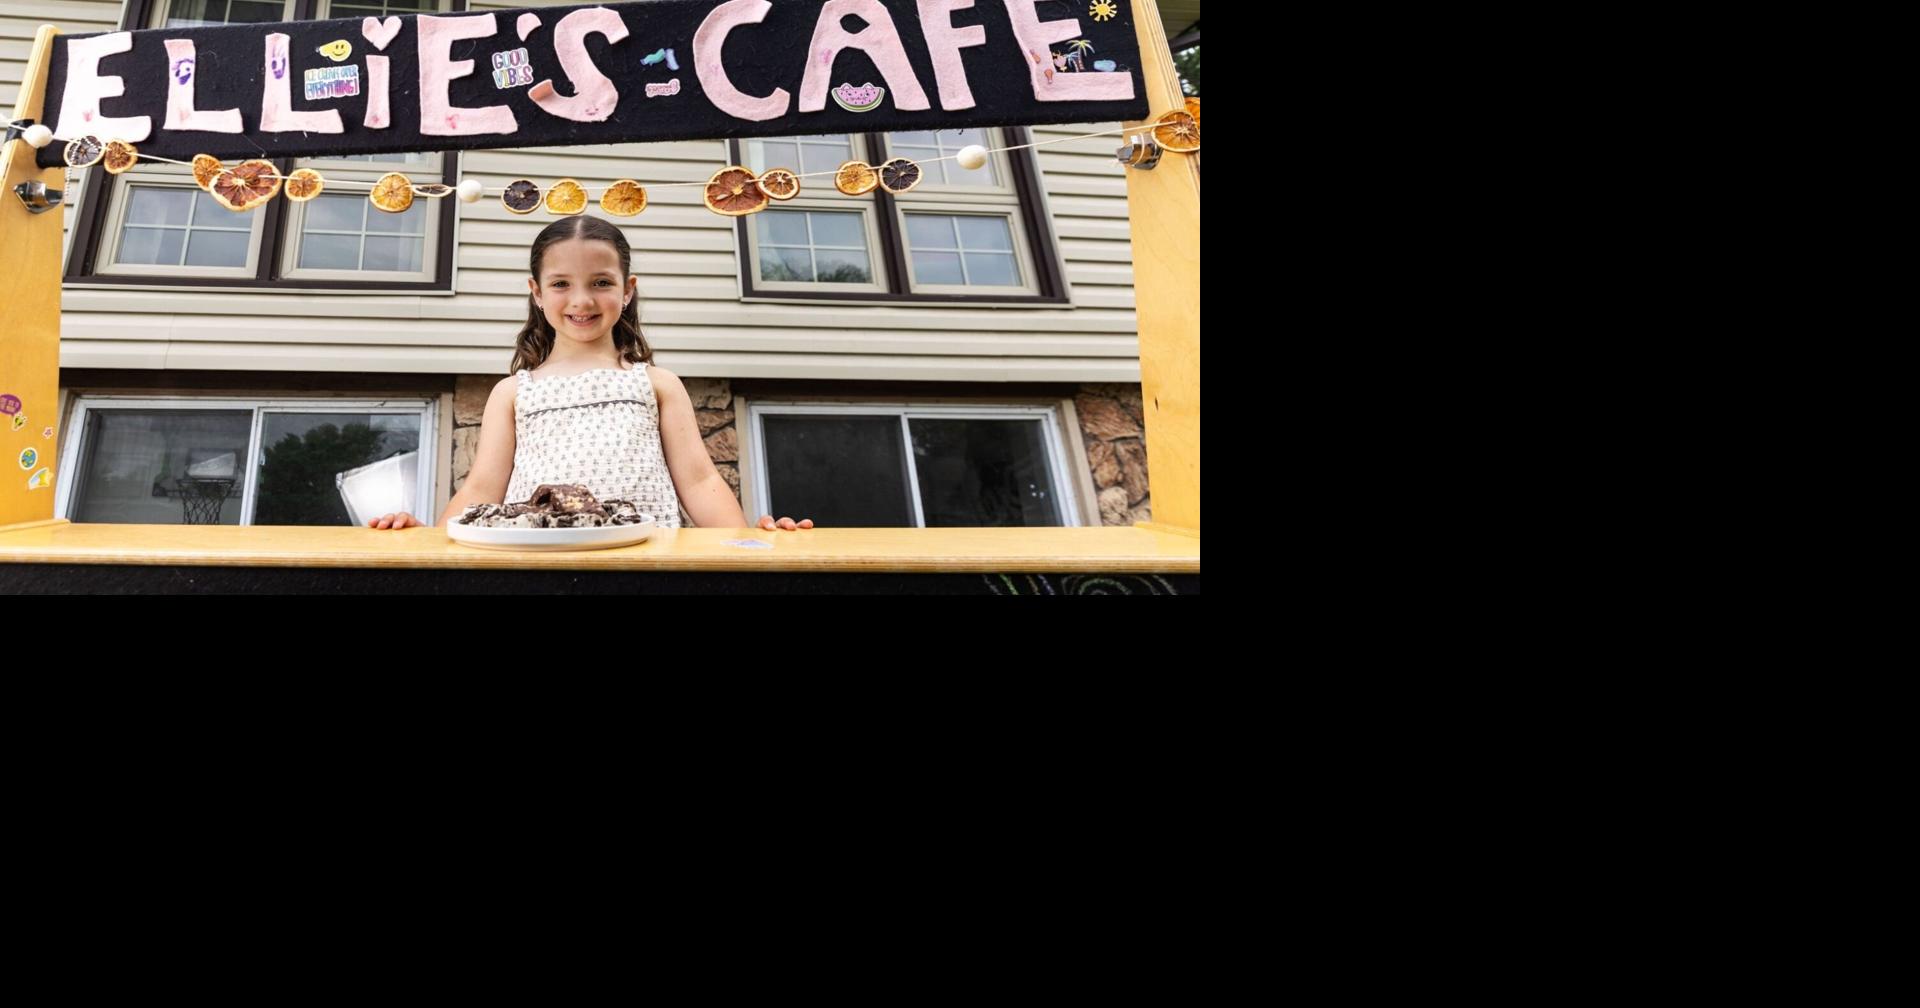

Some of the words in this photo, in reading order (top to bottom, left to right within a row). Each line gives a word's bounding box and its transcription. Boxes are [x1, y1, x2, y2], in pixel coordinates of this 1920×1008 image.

[494, 49, 528, 69] GOOD
[693, 0, 1135, 121] CAFE
[494, 65, 533, 87] VIBES
